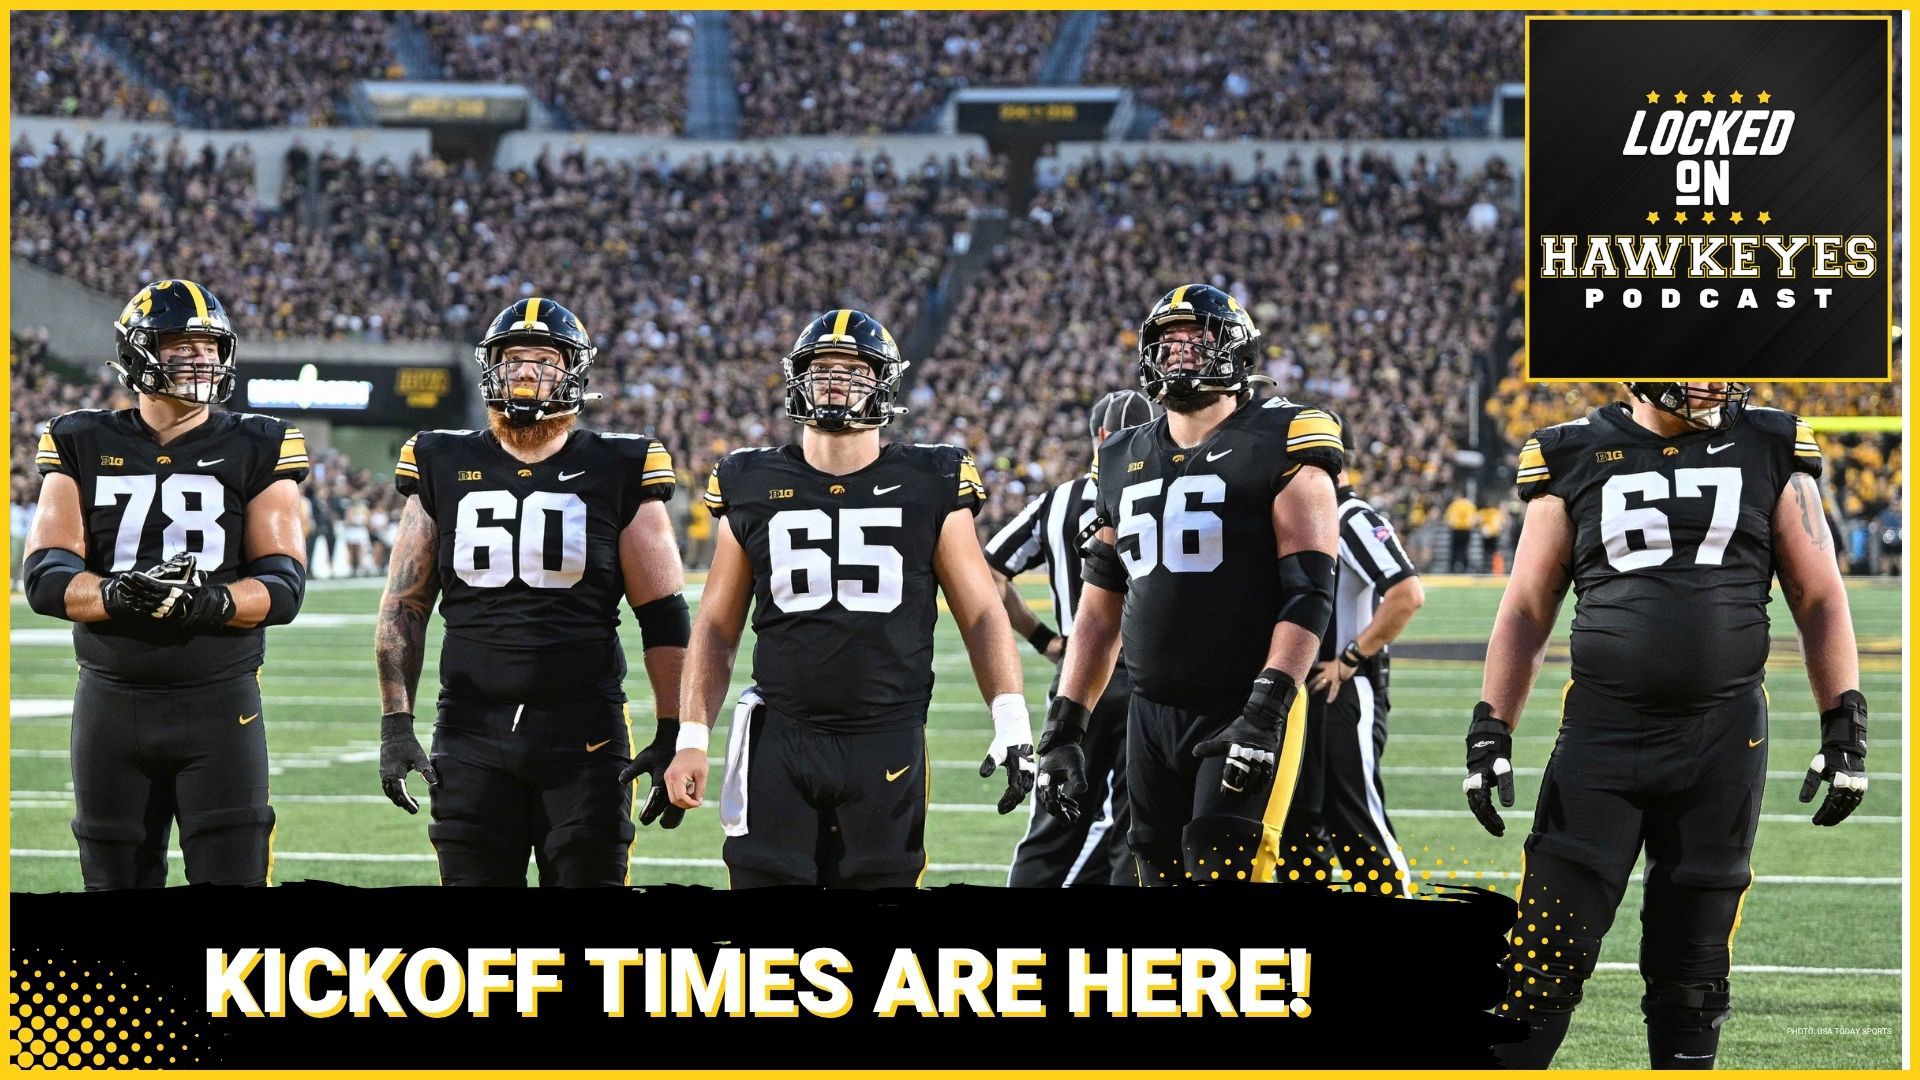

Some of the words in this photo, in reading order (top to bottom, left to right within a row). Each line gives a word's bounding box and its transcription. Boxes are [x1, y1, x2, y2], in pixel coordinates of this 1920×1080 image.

[94, 472, 226, 573] 78
[453, 489, 587, 589] 60
[768, 507, 904, 613] 65
[1116, 473, 1227, 581] 56
[1600, 467, 1743, 573] 67
